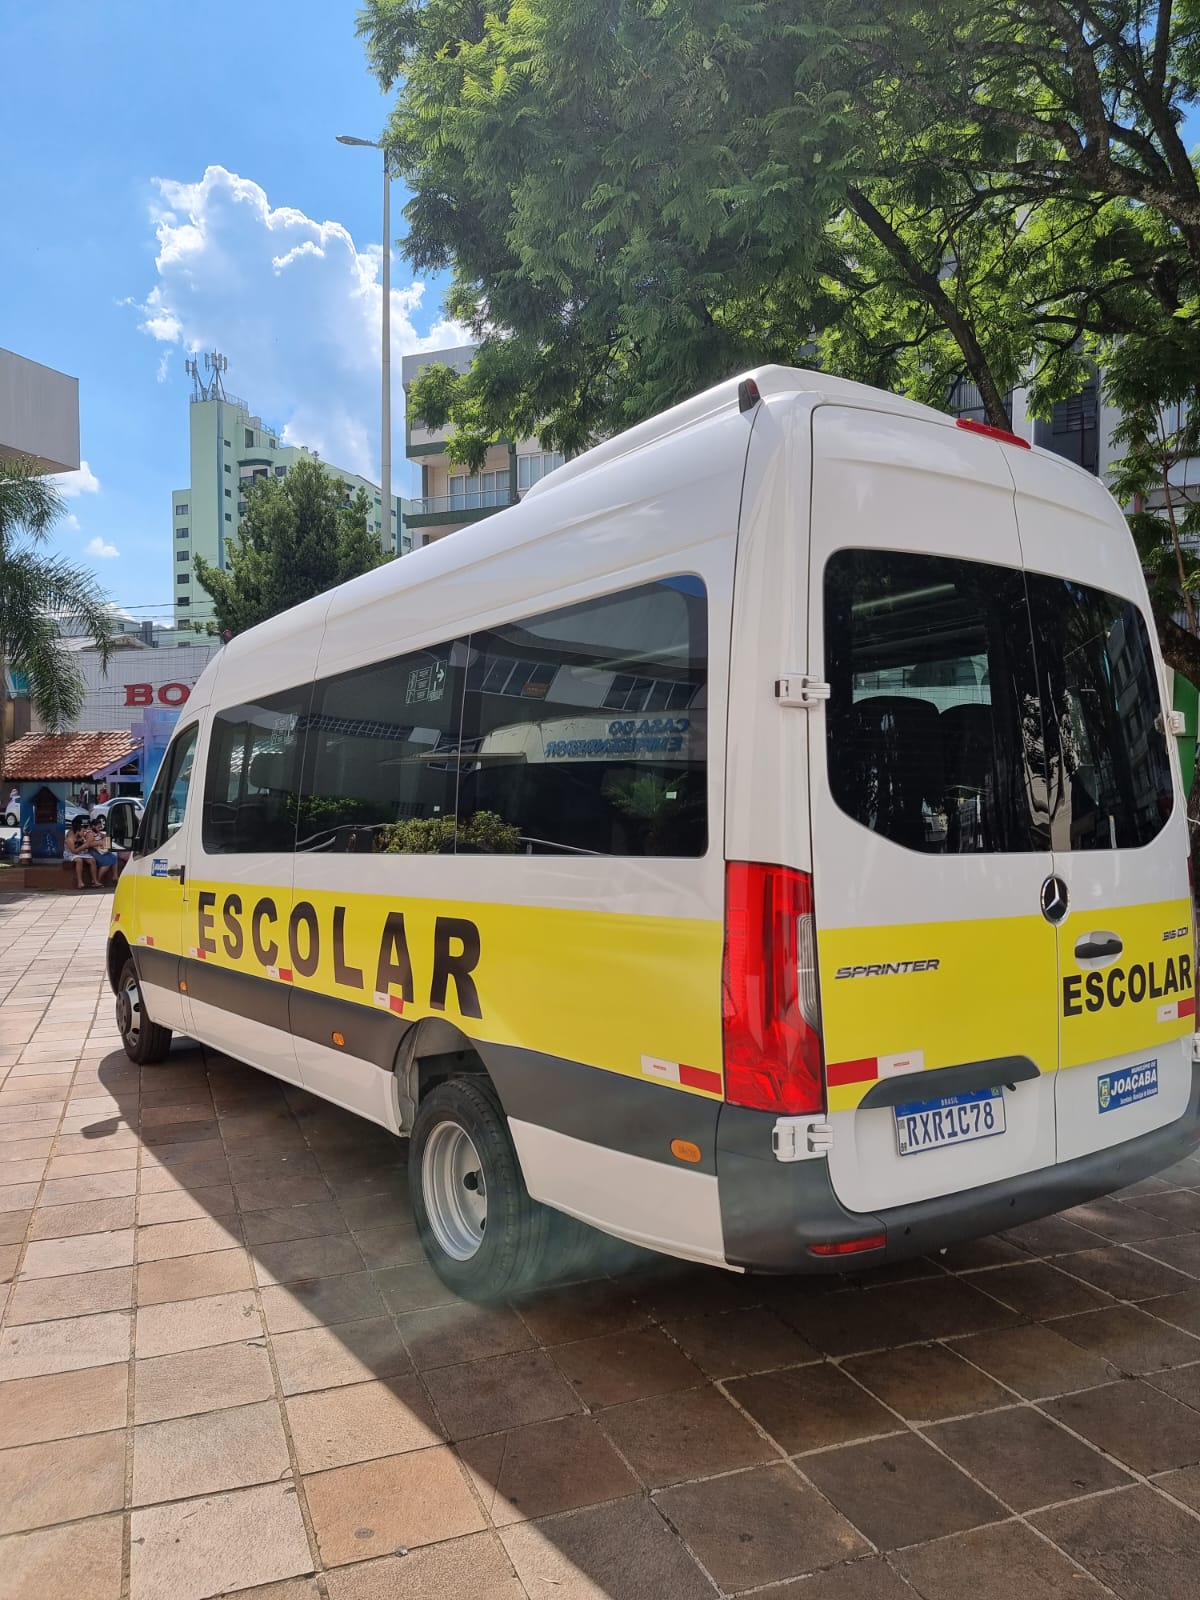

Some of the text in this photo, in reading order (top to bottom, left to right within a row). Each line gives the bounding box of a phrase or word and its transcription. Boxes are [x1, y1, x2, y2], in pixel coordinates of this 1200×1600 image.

[124, 682, 196, 706] BO
[198, 891, 483, 1019] ESCOLAR
[835, 959, 940, 980] SPRINTER
[1063, 954, 1192, 1017] ESCOLAR
[1111, 1069, 1156, 1096] JOAÇABA
[940, 1096, 960, 1107] BRASIL
[906, 1101, 995, 1147] RXR1C78
